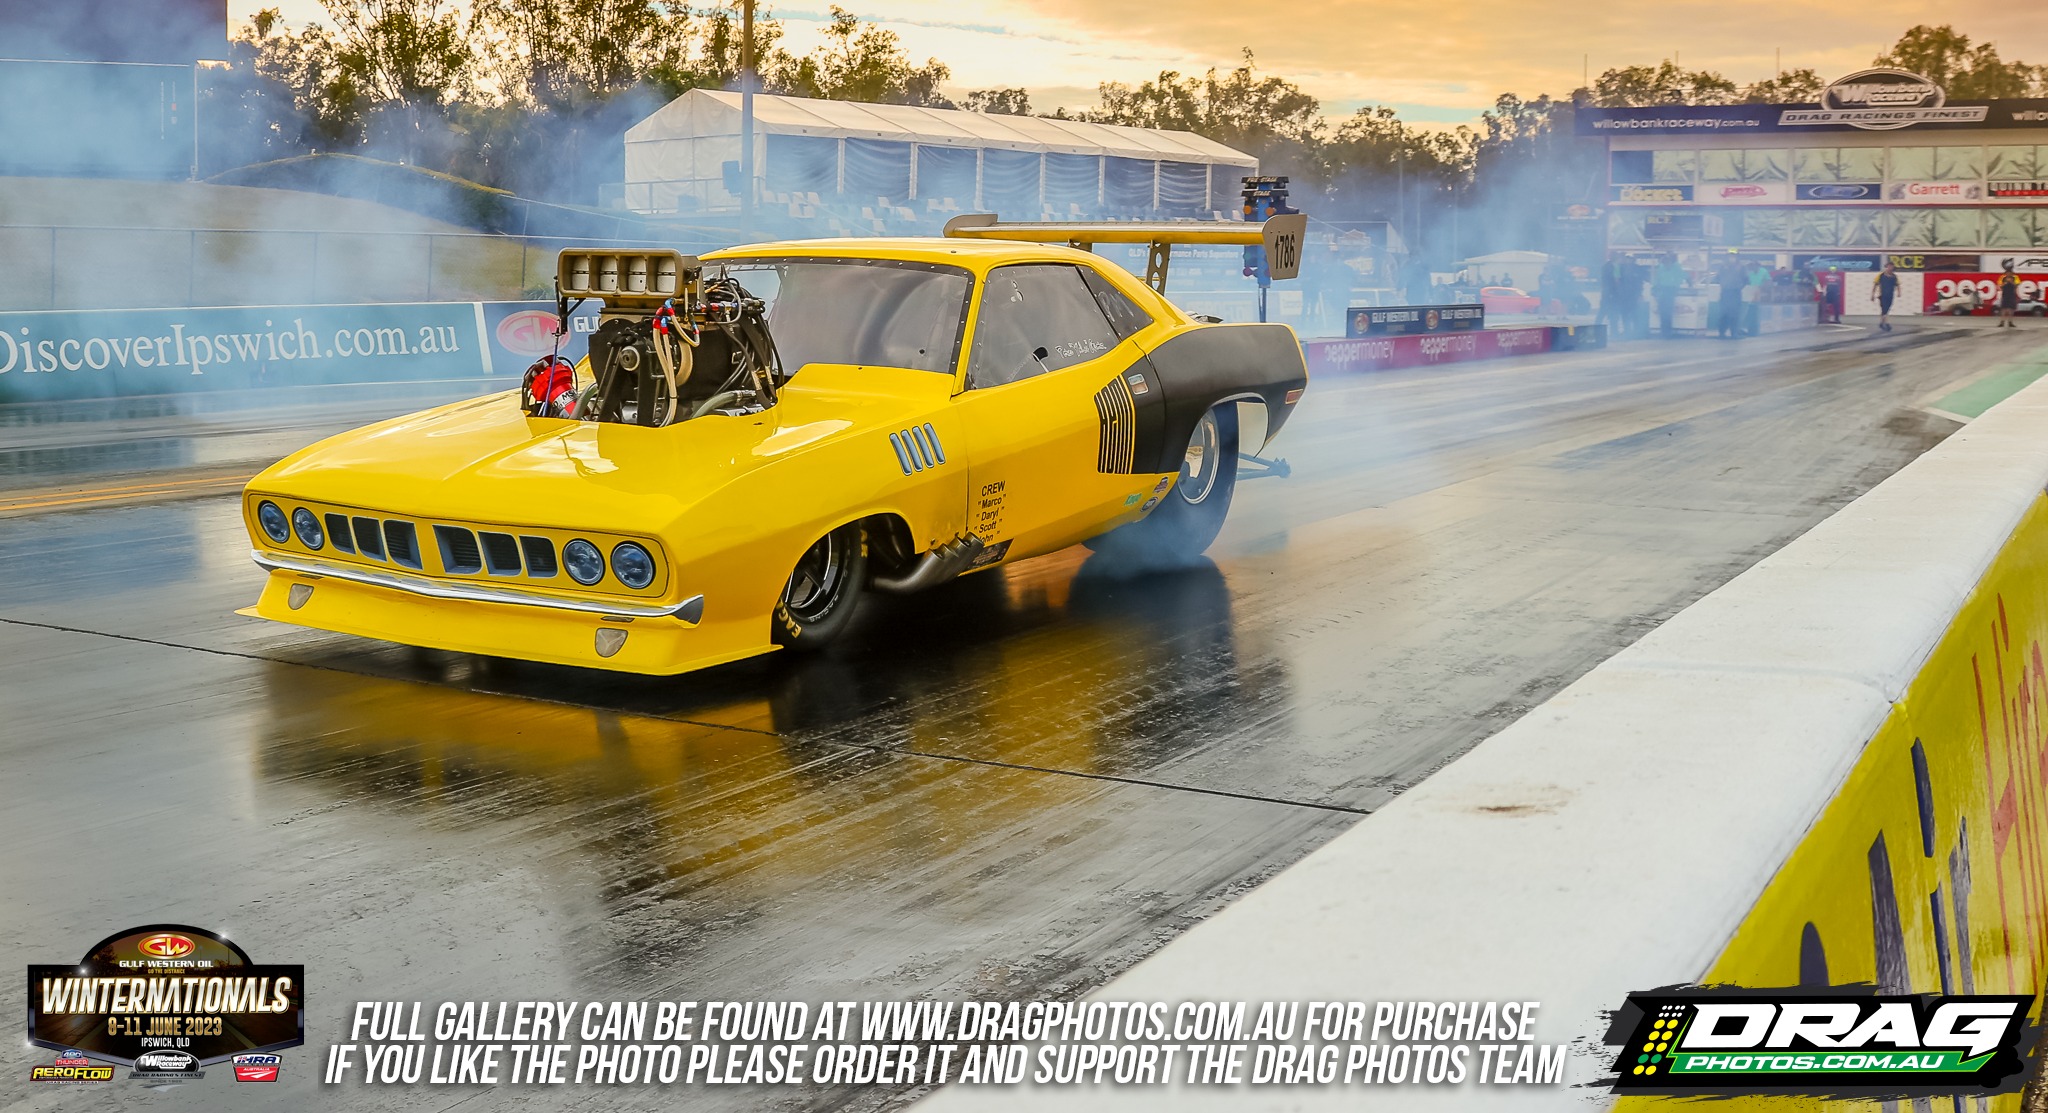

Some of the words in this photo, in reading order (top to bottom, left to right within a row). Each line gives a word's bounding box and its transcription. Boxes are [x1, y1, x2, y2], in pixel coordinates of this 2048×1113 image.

[1923, 110, 1981, 119] FINEST
[1592, 118, 1760, 129] willowbankraceway.com.au
[1909, 183, 1961, 196] Garrett
[1274, 233, 1295, 270] 1786
[981, 480, 1005, 497] CREW
